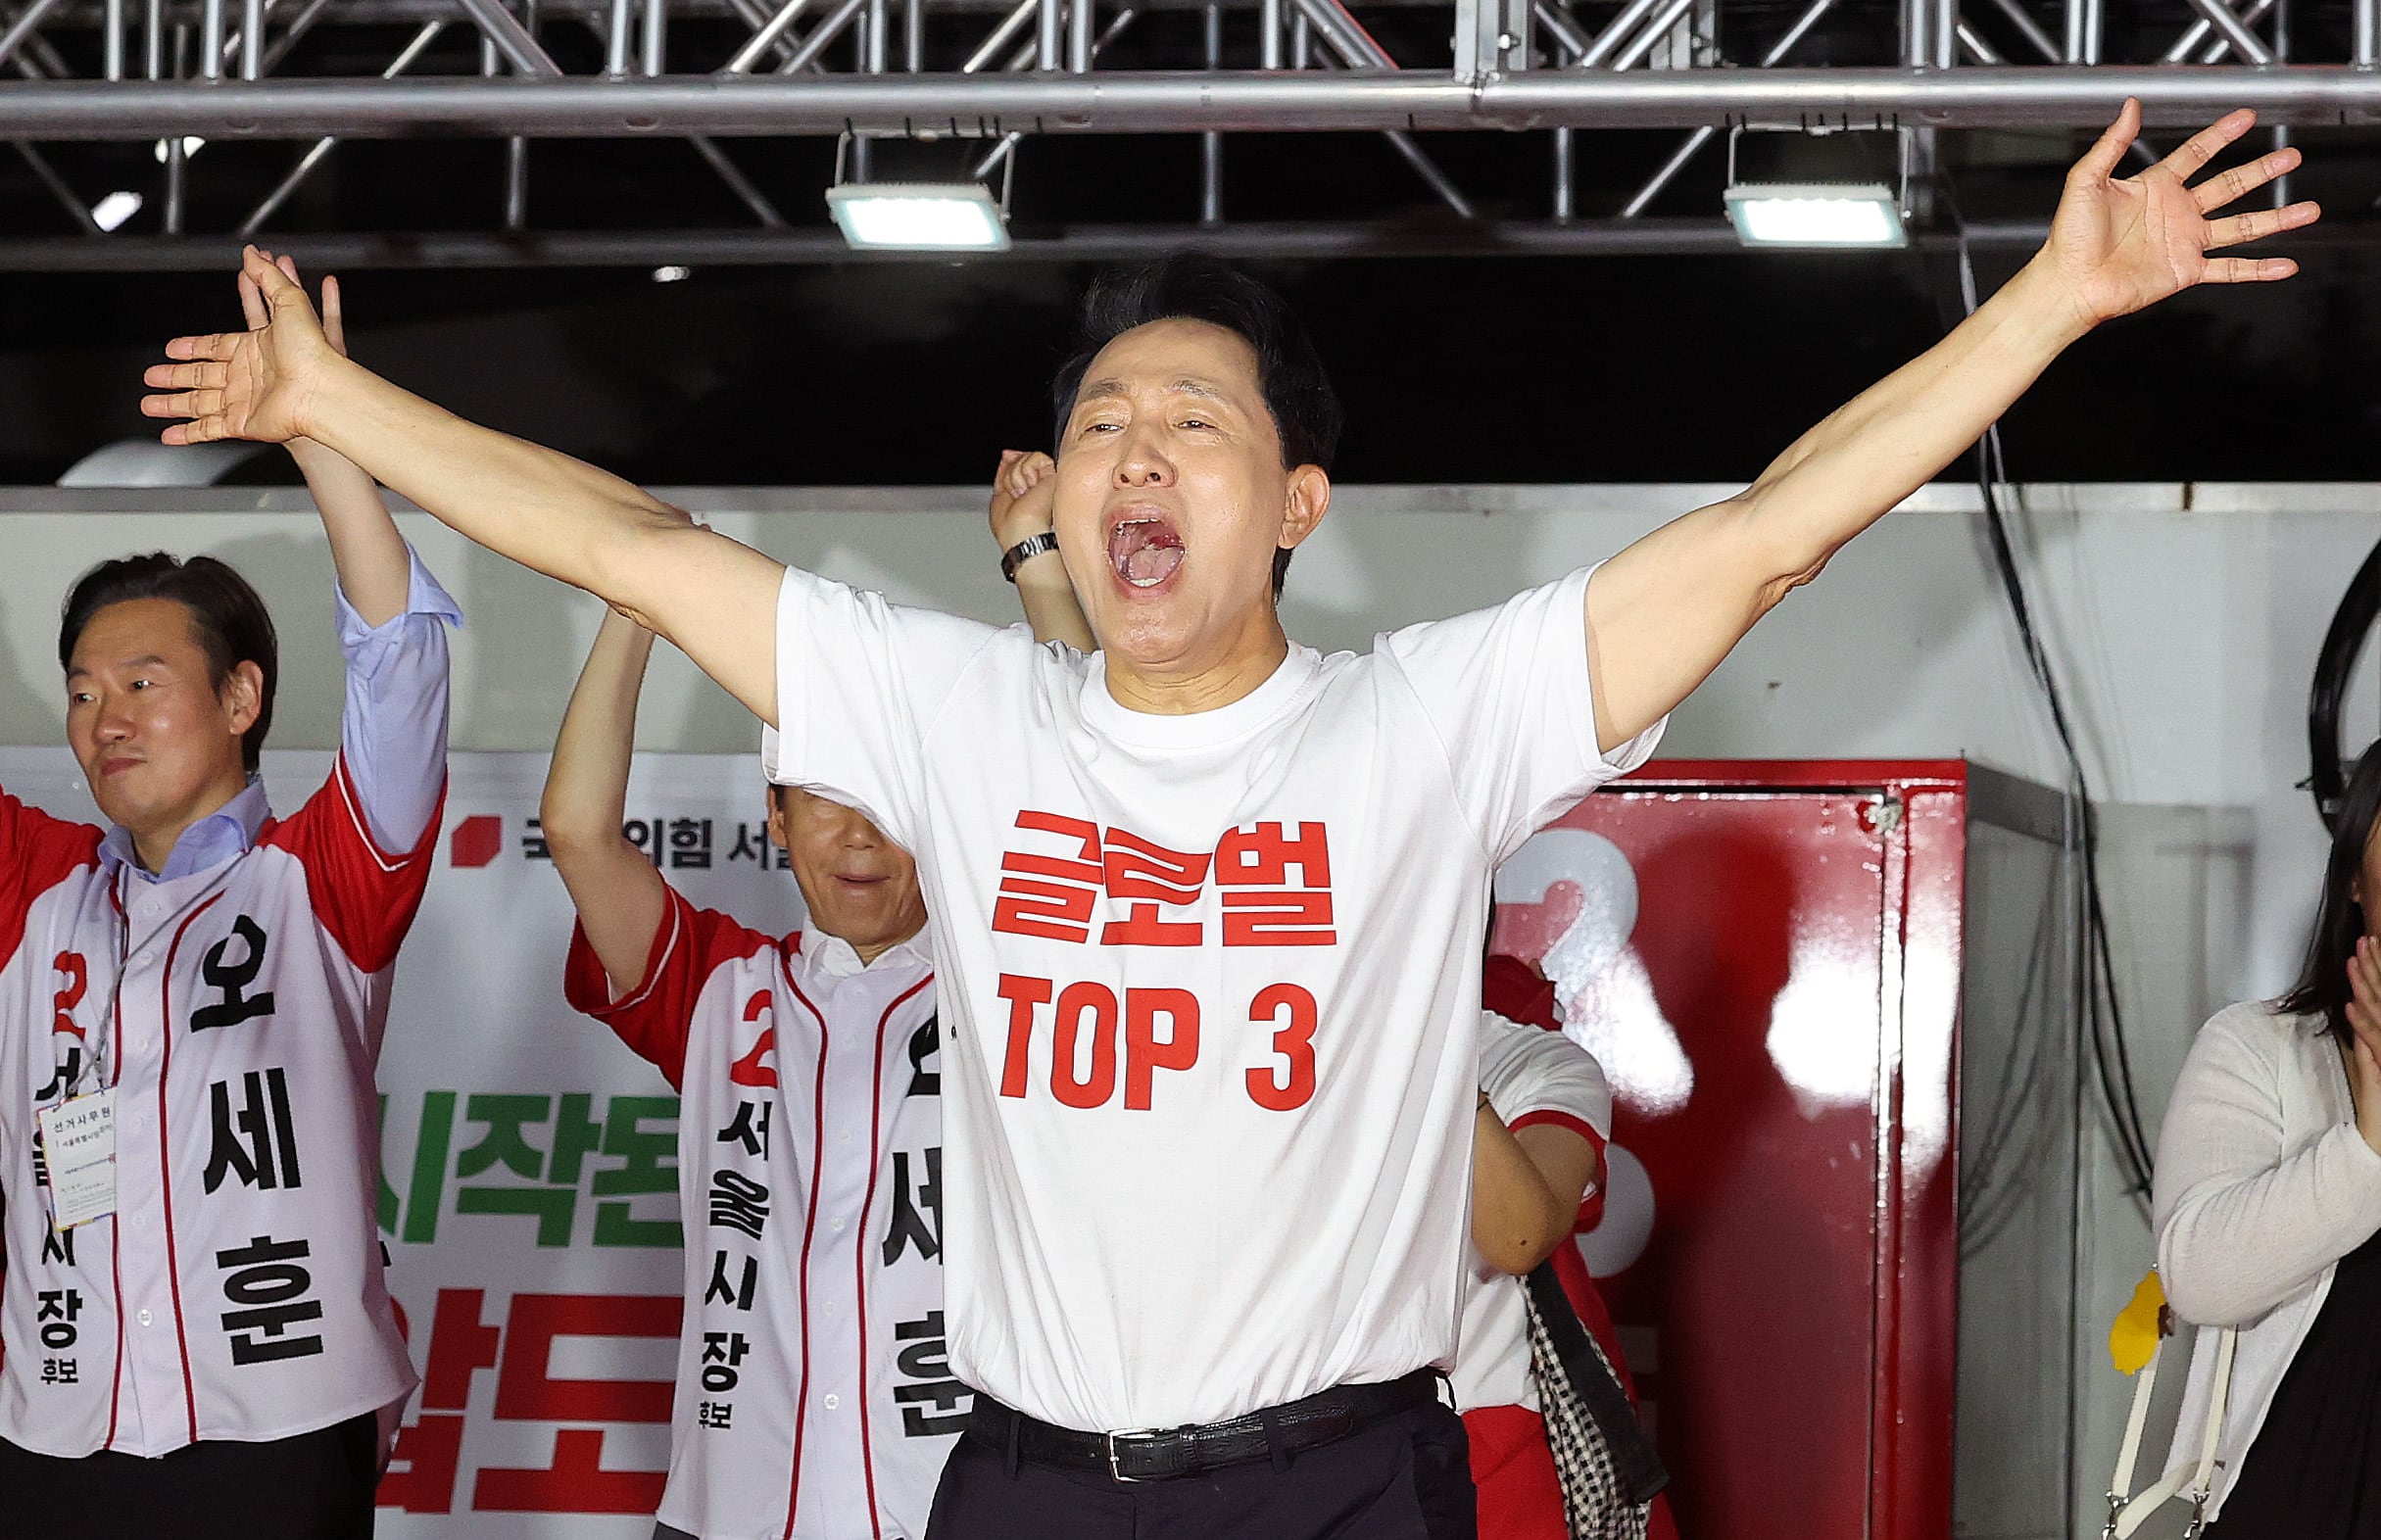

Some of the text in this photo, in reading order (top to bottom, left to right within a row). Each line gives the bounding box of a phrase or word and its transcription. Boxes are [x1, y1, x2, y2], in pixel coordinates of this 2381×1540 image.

[522, 817, 713, 870] 국의힘
[992, 809, 1337, 947] 글로벌
[52, 950, 88, 1041] 2
[730, 988, 778, 1088] 2
[997, 973, 1318, 1112] TOP 3
[53, 1106, 112, 1133] 선거사무원
[190, 914, 324, 1367] 오세훈
[40, 1358, 79, 1385] 후보
[699, 1401, 733, 1431] 후보
